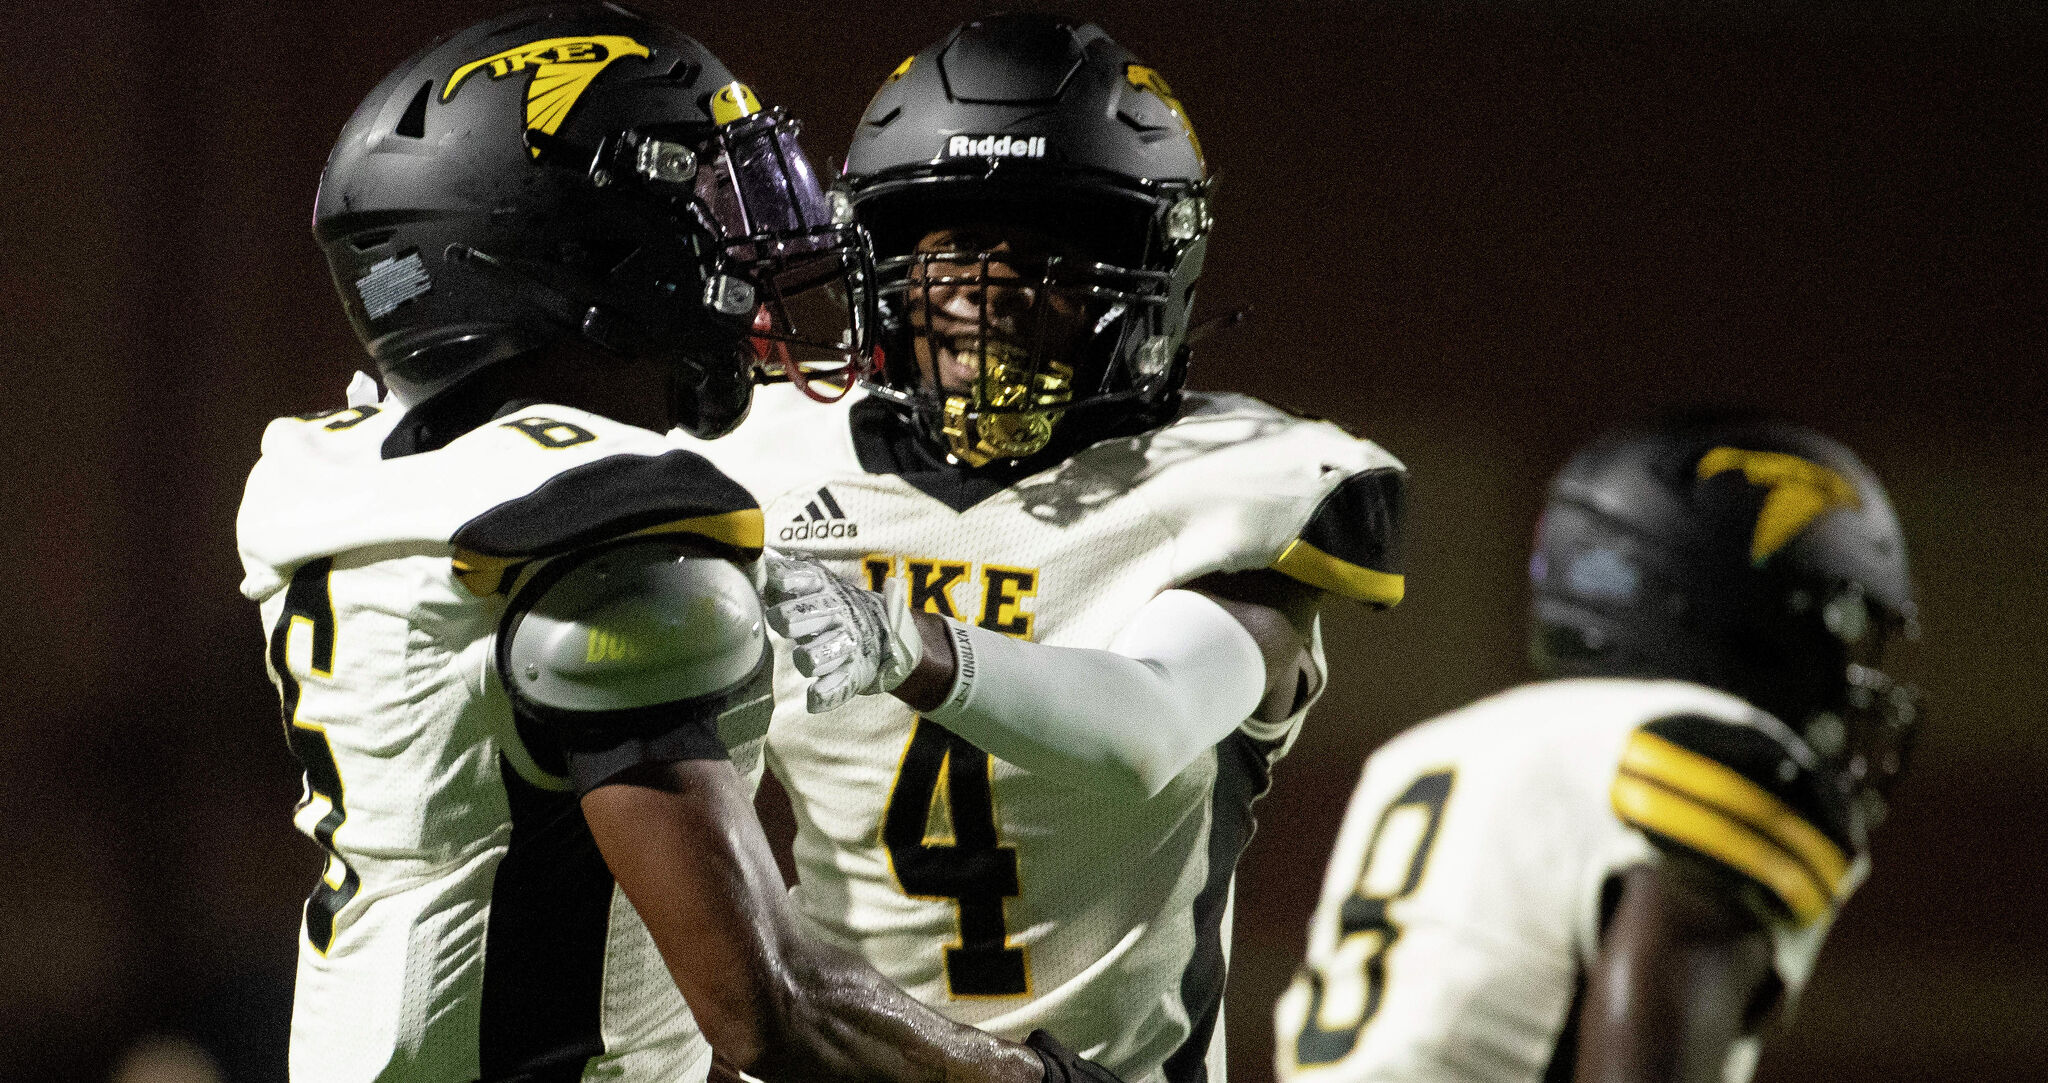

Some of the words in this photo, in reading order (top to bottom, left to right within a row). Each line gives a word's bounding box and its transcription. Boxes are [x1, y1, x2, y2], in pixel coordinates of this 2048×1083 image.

[490, 42, 597, 77] IKE
[949, 136, 1046, 158] Riddell
[779, 520, 859, 542] adidas
[877, 712, 1034, 1000] 4
[1293, 768, 1459, 1070] 8
